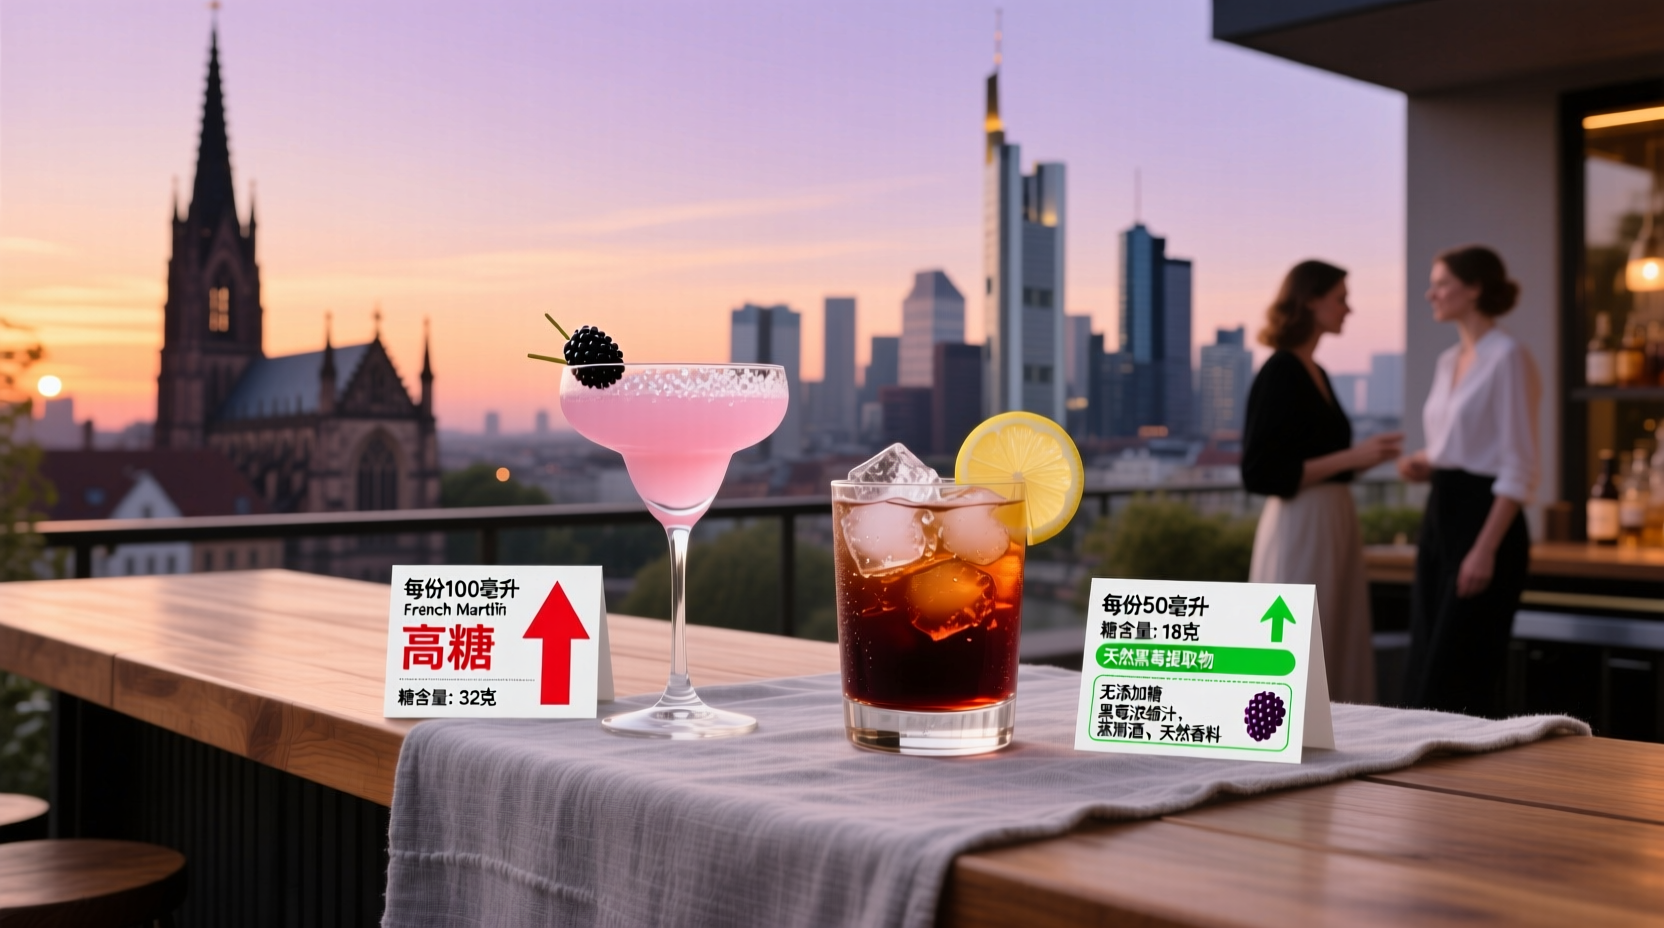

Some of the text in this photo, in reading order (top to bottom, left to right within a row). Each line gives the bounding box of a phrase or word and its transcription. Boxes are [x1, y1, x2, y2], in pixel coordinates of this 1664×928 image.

[403, 576, 520, 600] 每份100毫升
[403, 601, 452, 617] French
[1101, 593, 1210, 618] 每份50毫升
[401, 622, 496, 671] 高糖
